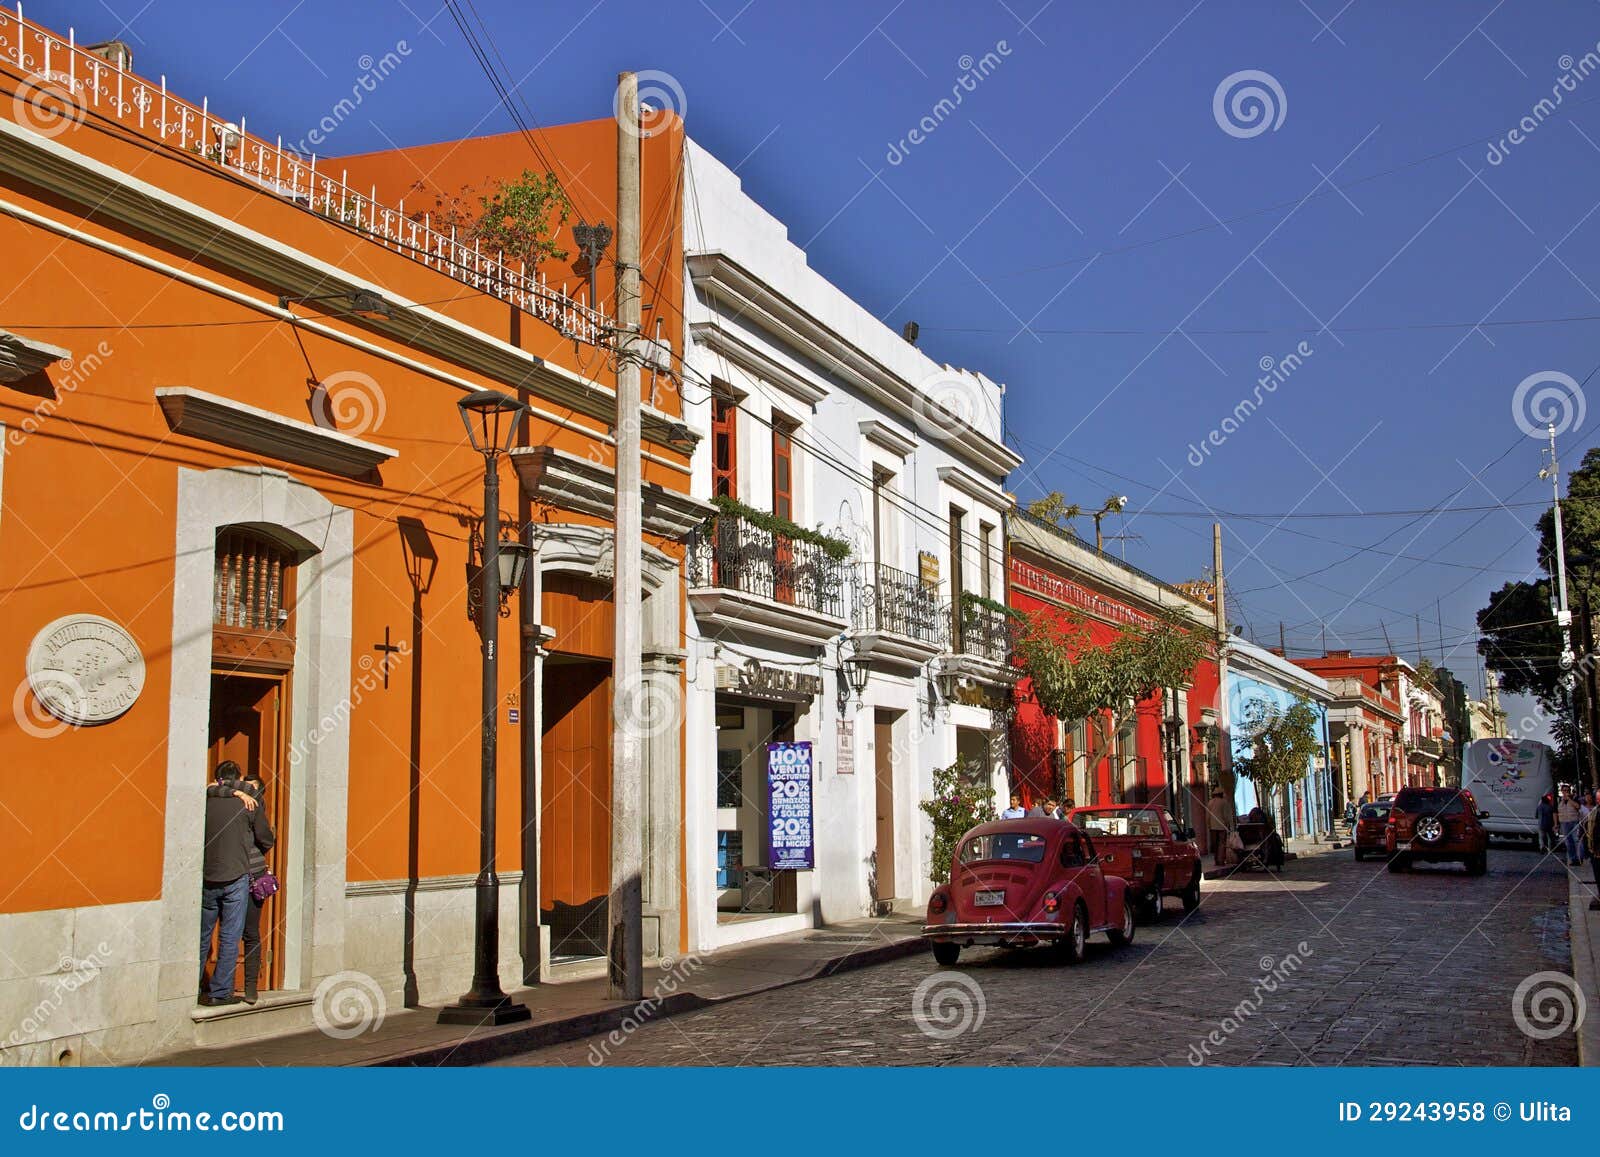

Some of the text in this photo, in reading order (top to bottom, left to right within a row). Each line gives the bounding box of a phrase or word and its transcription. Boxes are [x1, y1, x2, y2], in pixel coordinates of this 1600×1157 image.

[770, 749, 809, 765] HOY
[771, 764, 810, 774] VENTA
[772, 779, 809, 798] 20%
[780, 809, 810, 817] SOLAR
[772, 818, 810, 835] 20%
[785, 840, 811, 848] MICAS
